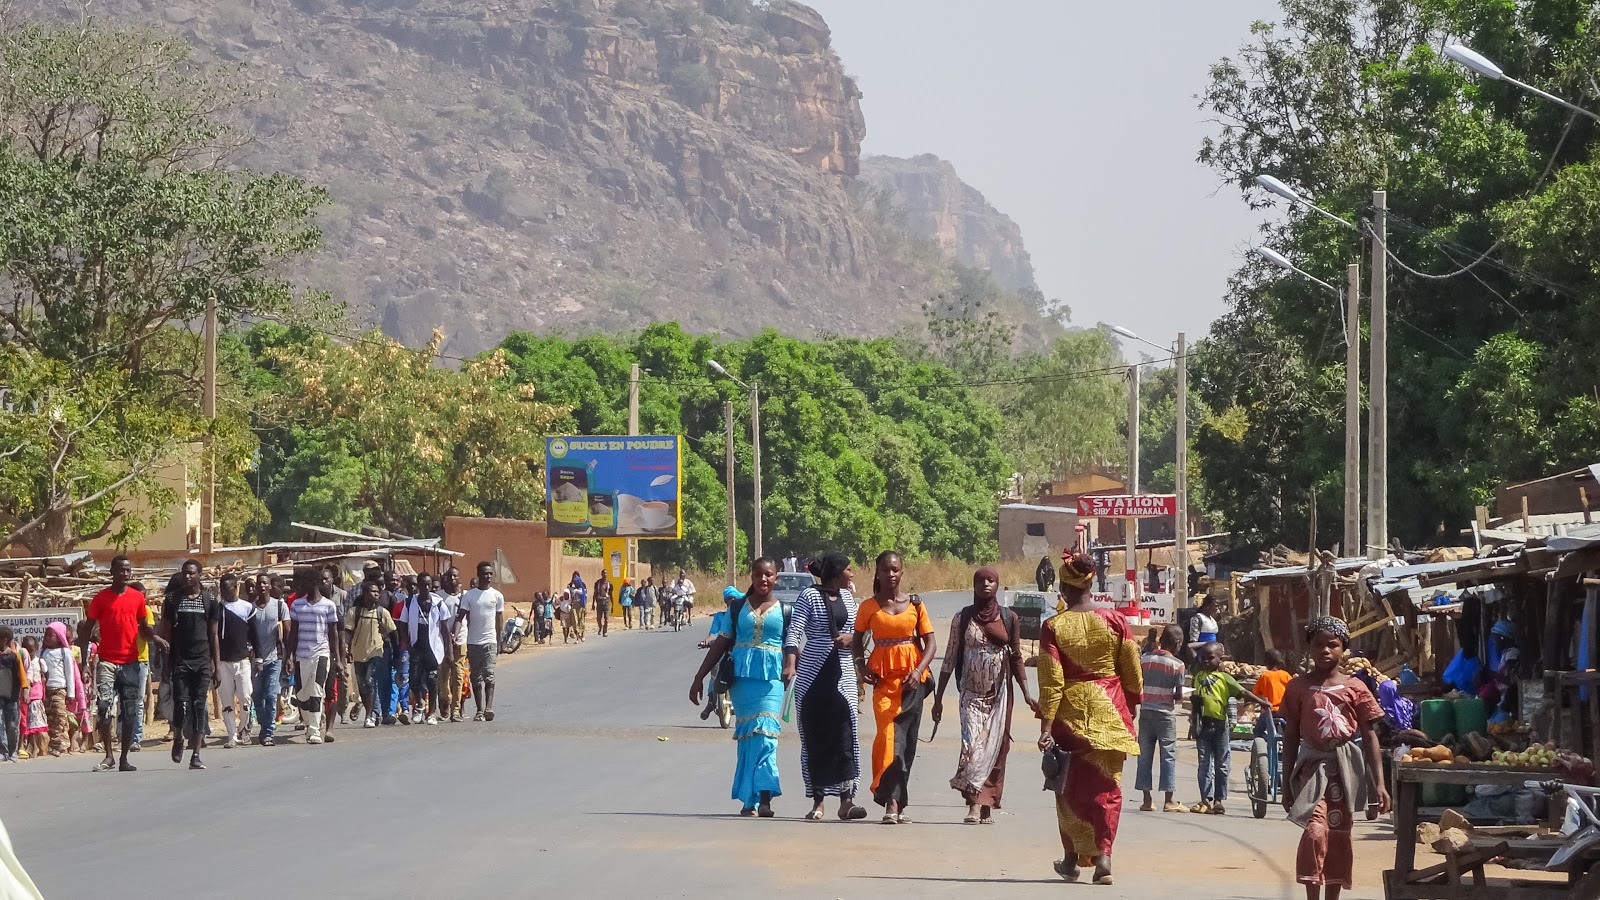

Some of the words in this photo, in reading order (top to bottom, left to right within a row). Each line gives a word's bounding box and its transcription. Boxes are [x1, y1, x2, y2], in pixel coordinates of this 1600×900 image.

[569, 441, 607, 451] SUCRE
[608, 441, 625, 451] EN
[626, 440, 674, 450] POUDRE
[1092, 497, 1164, 508] STATION
[1092, 507, 1111, 515] SIBY
[1113, 507, 1123, 515] ET
[1126, 507, 1169, 515] MARAKALA
